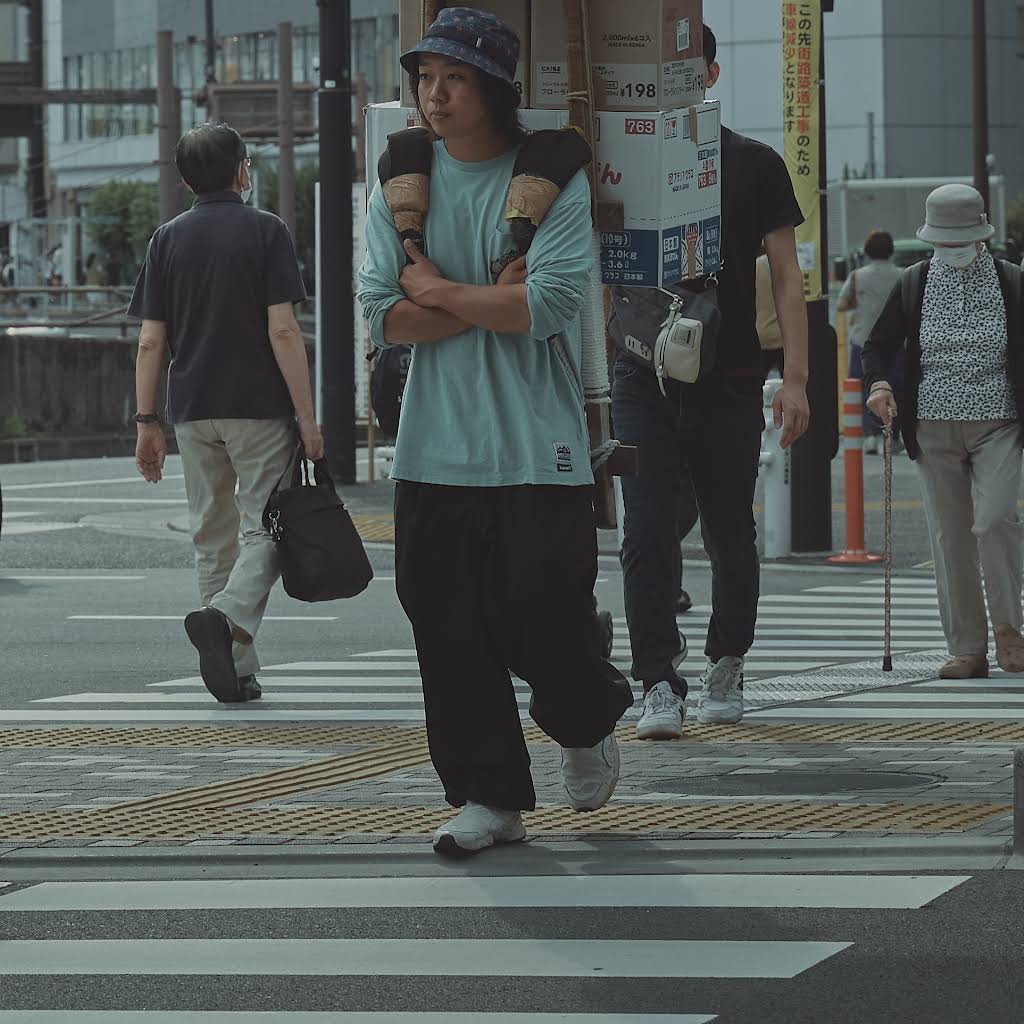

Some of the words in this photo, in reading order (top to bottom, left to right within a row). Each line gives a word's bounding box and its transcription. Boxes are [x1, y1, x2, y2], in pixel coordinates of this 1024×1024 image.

[541, 65, 561, 73] CAINZ
[620, 83, 657, 98] ¥198
[627, 120, 654, 133] 763
[607, 249, 638, 260] 2.0kg
